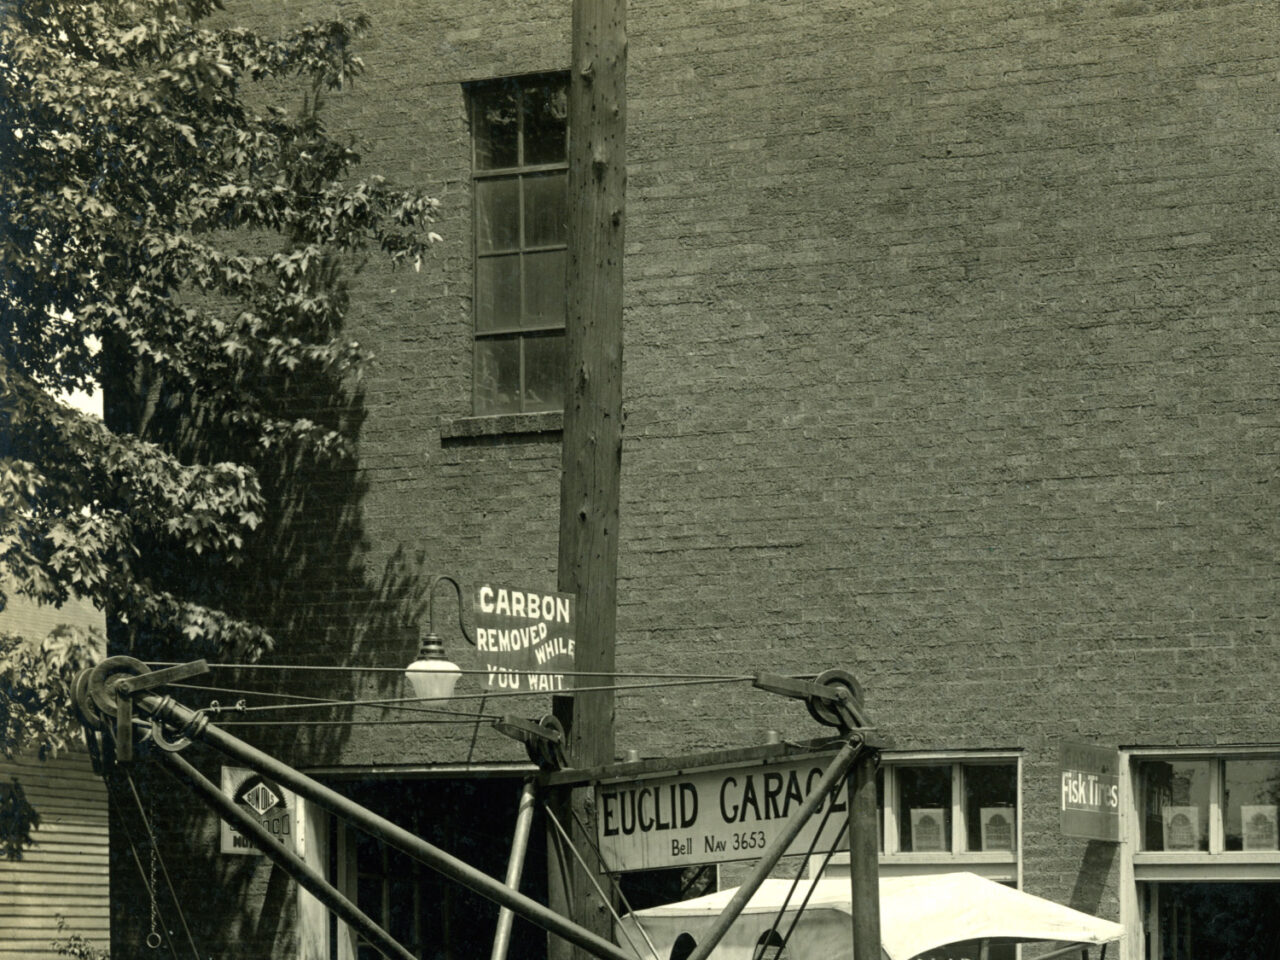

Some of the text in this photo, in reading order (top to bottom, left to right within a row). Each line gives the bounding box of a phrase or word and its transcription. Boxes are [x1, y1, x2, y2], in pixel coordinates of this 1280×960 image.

[480, 585, 570, 623] CARBON
[477, 622, 576, 665] REMOVED WHILE
[487, 664, 520, 689] YOU
[601, 782, 699, 837] EUCLID
[1062, 771, 1118, 811] Fisk Tires
[671, 837, 693, 856] Bell
[732, 830, 767, 851] 3653
